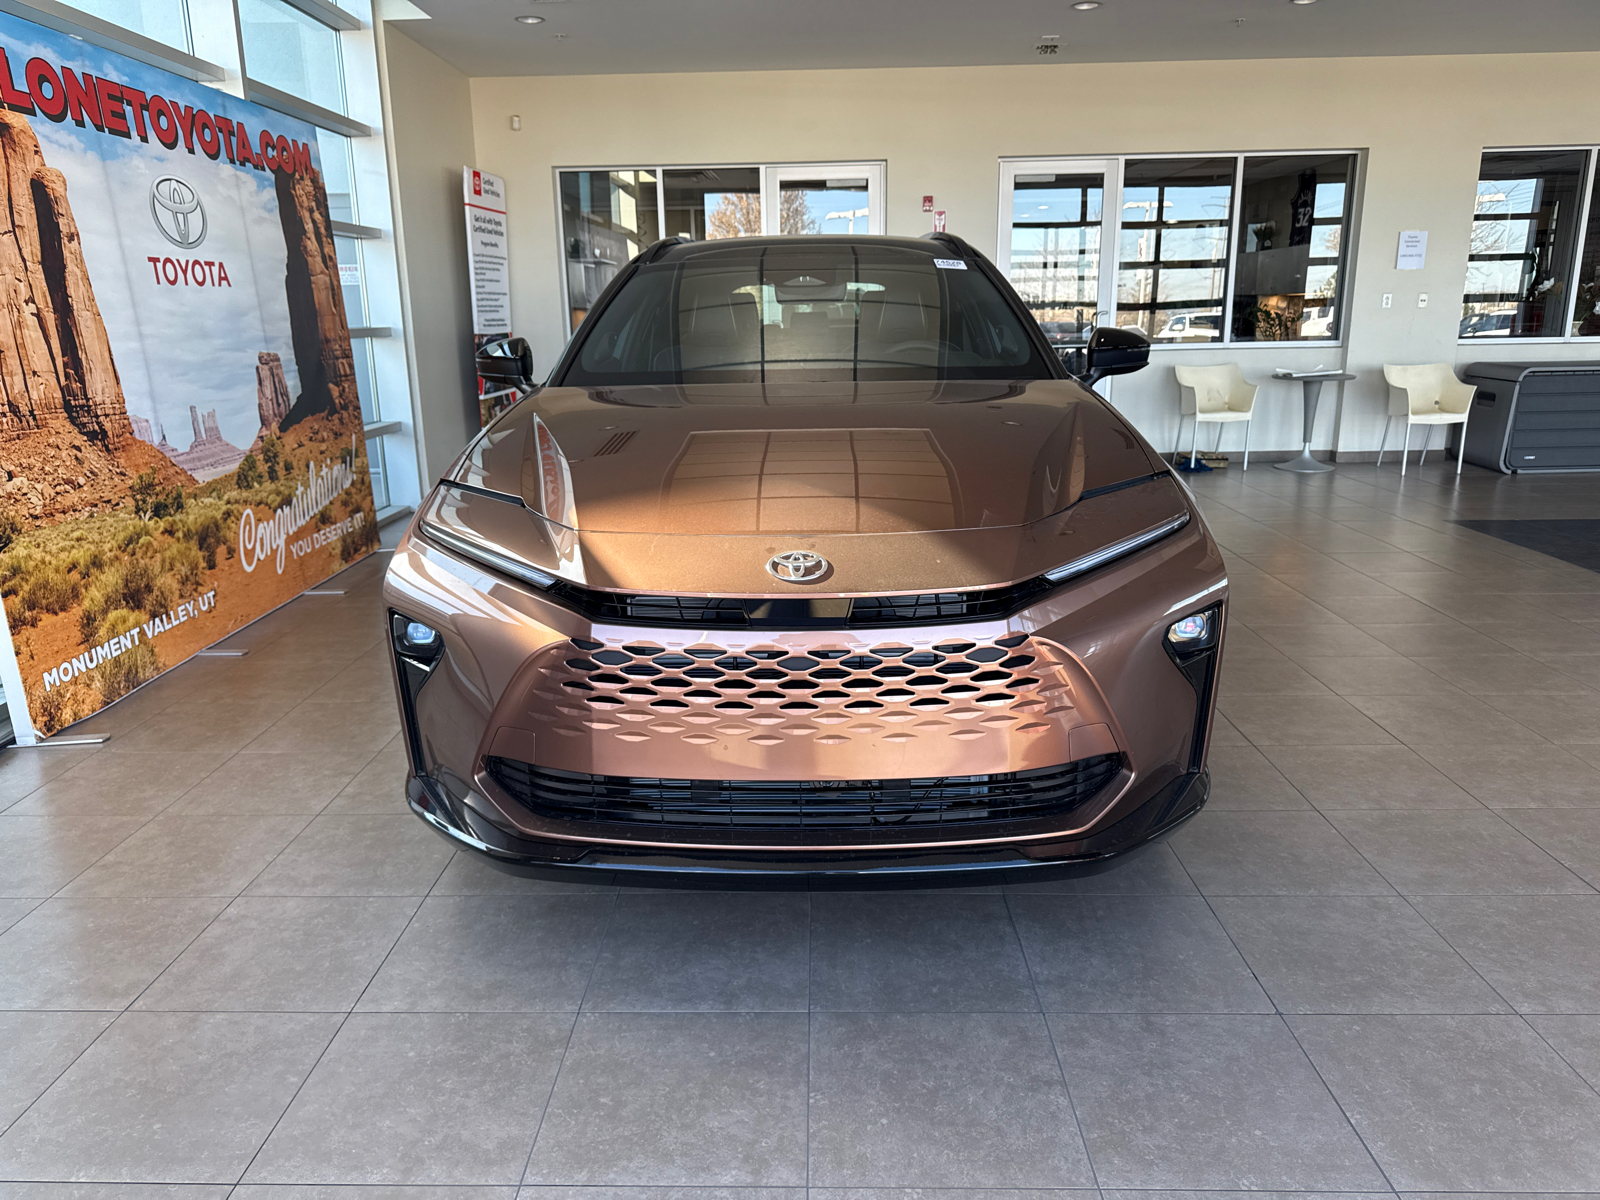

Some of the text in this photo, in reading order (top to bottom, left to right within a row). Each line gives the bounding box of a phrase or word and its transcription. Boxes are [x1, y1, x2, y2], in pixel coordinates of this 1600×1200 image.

[1295, 206, 1312, 227] 32
[147, 256, 231, 287] TOYOTA
[239, 433, 357, 575] Congratulations!
[289, 511, 366, 559] YOU DESERVE IT!
[42, 590, 216, 692] MONUMENT VALLEY, UT
